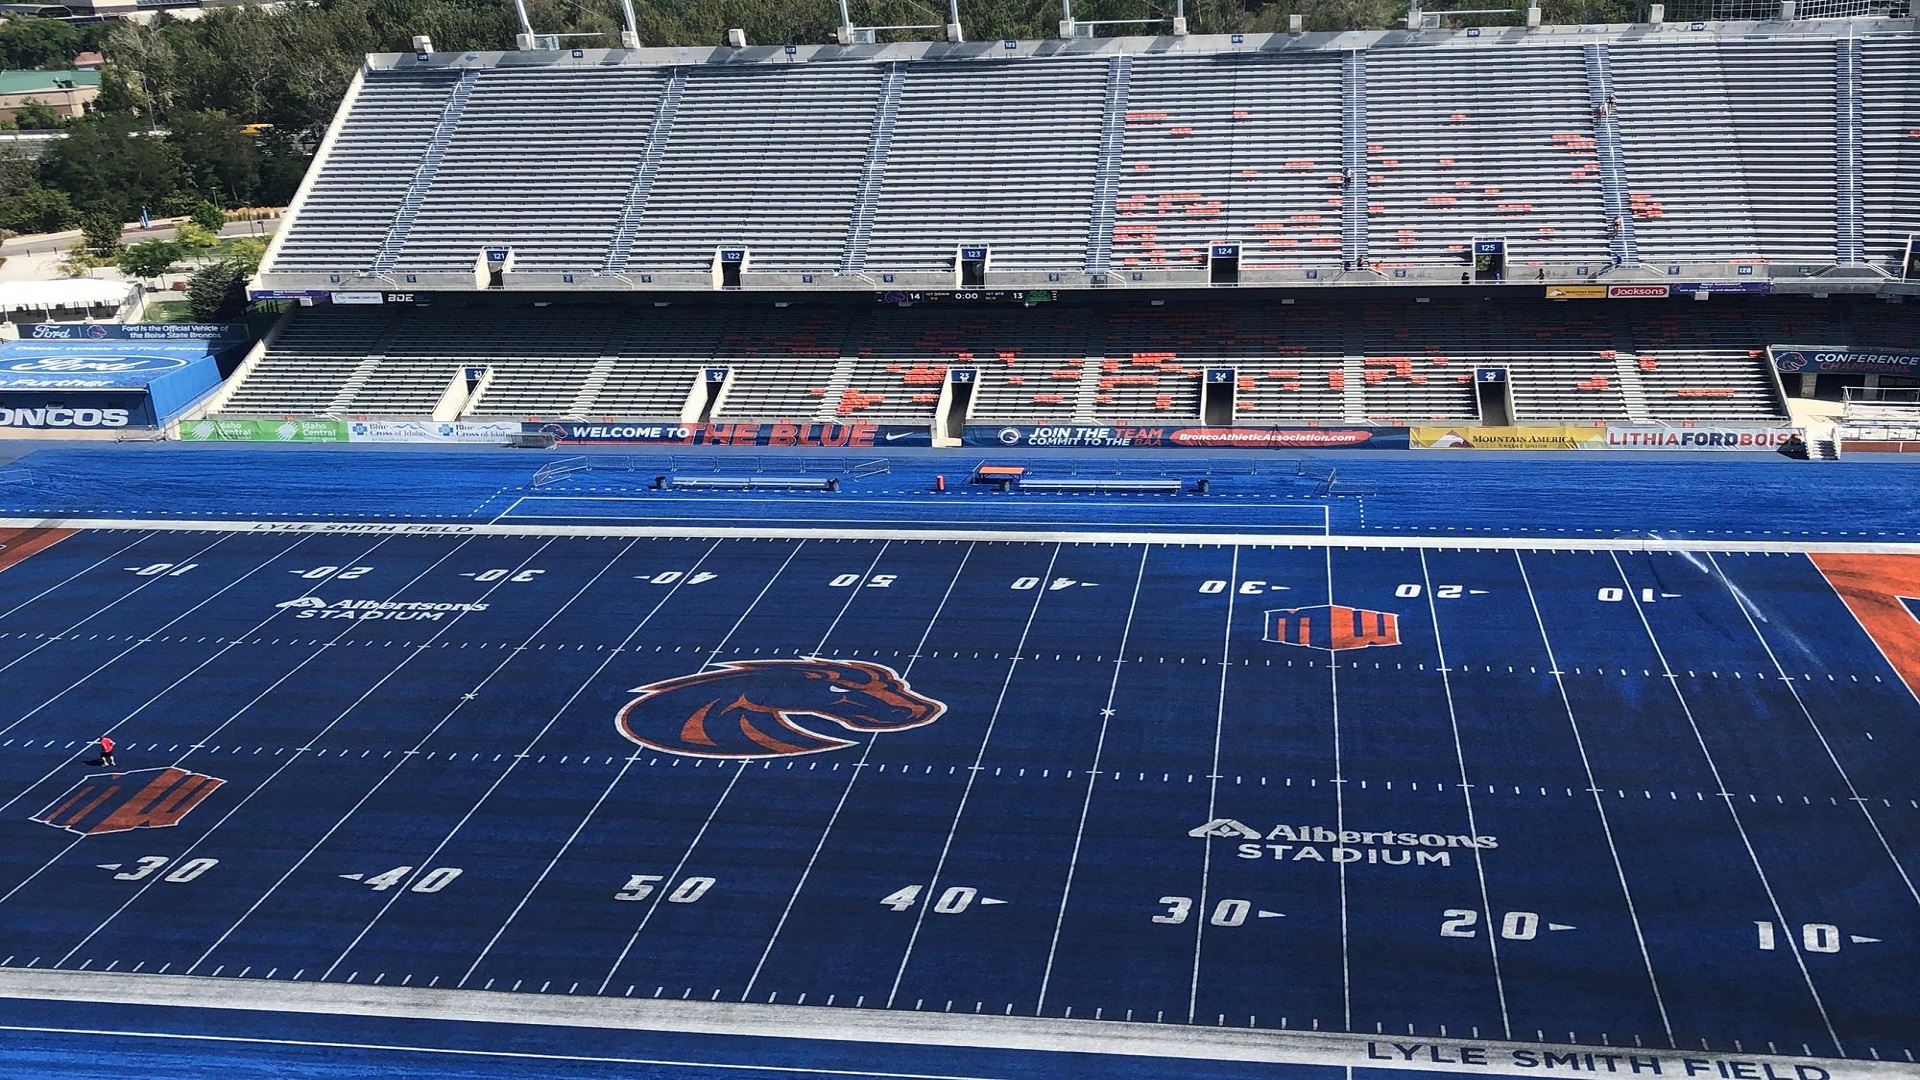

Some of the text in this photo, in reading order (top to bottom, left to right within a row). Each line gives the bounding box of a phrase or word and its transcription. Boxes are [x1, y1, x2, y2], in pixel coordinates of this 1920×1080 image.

[1614, 288, 1665, 296] Jacksons
[33, 324, 71, 338] Ford
[10, 356, 150, 371] Ford
[1815, 353, 1920, 366] CONFERENCE
[1820, 361, 1910, 373] CHAMPIONS
[8, 379, 115, 387] Further
[573, 423, 878, 446] WELCOME TO THE BLUE
[1028, 427, 1164, 439] JOIN THE TEAM
[1179, 432, 1356, 442] BroncoAthleticAssociation.com
[1472, 435, 1575, 443] MOUNTAIN AMERICA
[1028, 438, 1079, 446] COMMIT
[1084, 438, 1102, 446] TO
[1105, 438, 1132, 446] THE
[252, 523, 475, 534] LYLE SMITH FIELD
[328, 599, 490, 612] Albertsons
[296, 609, 445, 621] STADIUM
[1266, 824, 1499, 849] Albertsons
[1237, 843, 1452, 867] STADIUM
[113, 855, 219, 883] 30
[363, 866, 463, 893] 40
[614, 874, 717, 904] 50
[880, 884, 978, 914] 40
[1151, 896, 1252, 927] 30
[1440, 908, 1540, 941] 20
[1753, 920, 1841, 954] 10
[1366, 1041, 1833, 1080] LYLE SMITH FIELD
